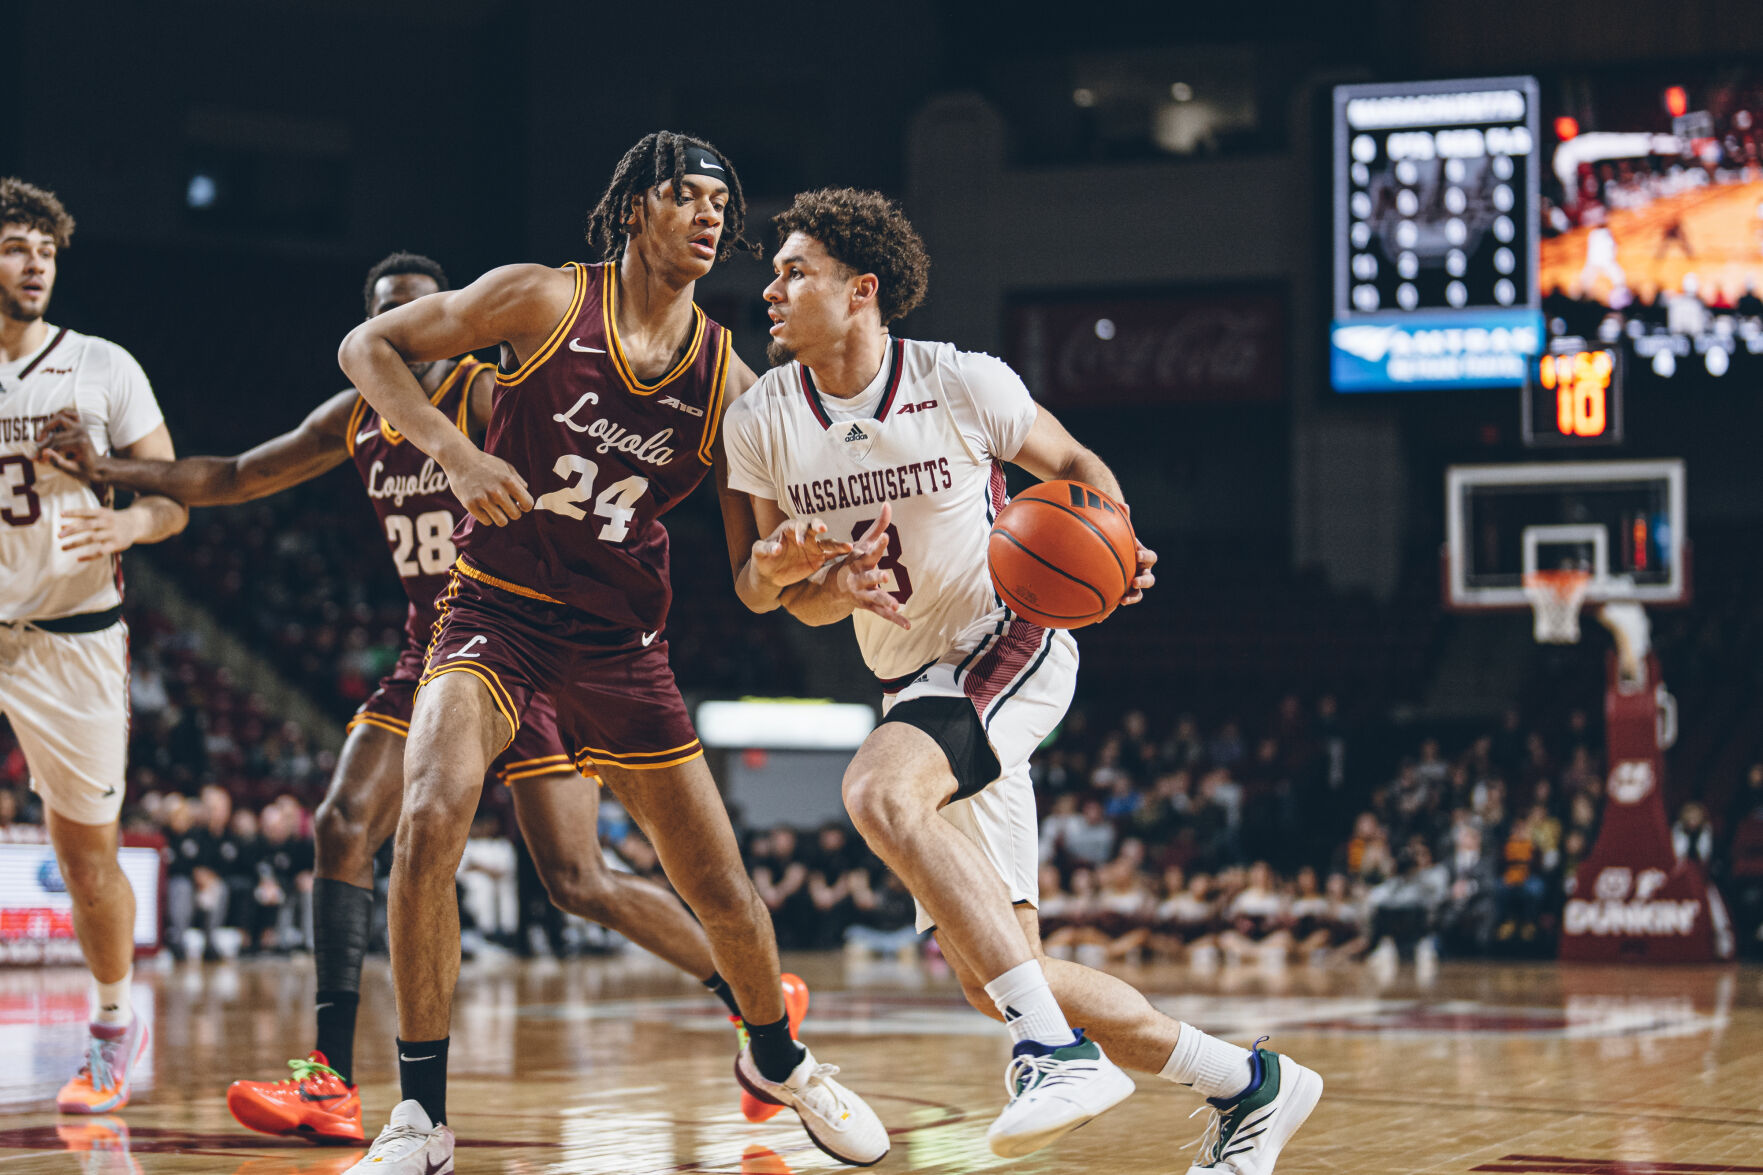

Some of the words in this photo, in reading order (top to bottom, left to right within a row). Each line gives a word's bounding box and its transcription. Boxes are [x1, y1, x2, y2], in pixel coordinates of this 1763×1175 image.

[553, 392, 674, 466] Loyola
[657, 395, 704, 417] A10
[896, 400, 938, 415] A10
[844, 433, 868, 443] adidas
[367, 459, 450, 507] Loyola
[534, 454, 649, 543] 24
[788, 457, 952, 515] MASSACHUSETTS
[384, 510, 457, 577] 28
